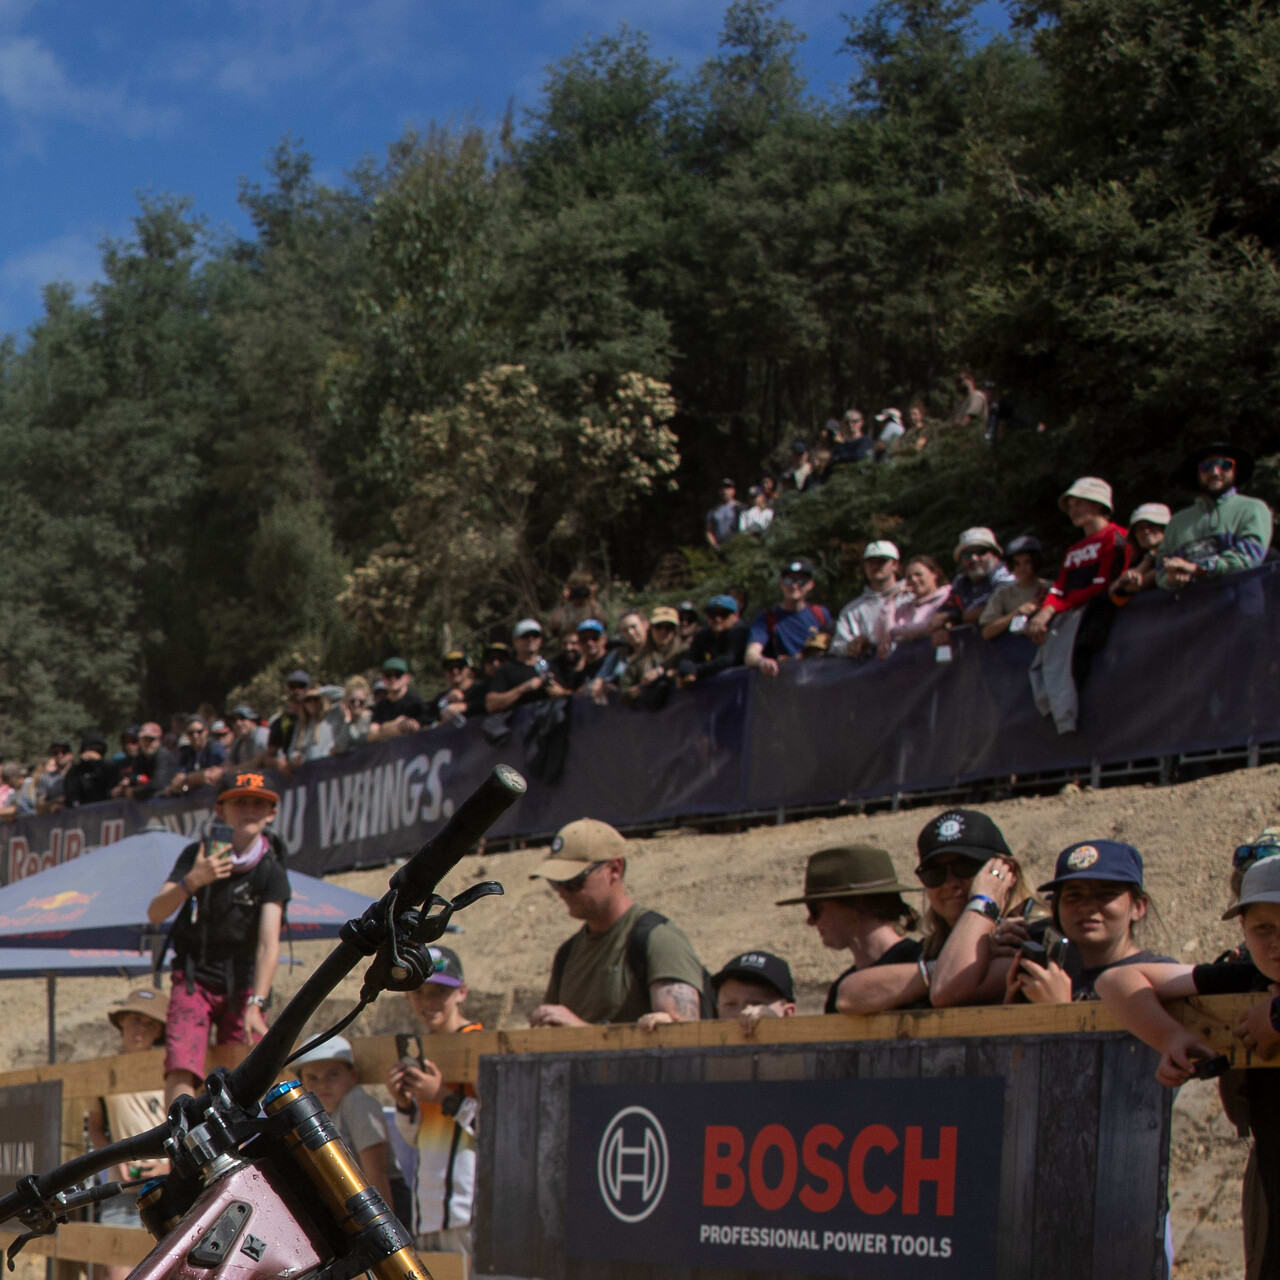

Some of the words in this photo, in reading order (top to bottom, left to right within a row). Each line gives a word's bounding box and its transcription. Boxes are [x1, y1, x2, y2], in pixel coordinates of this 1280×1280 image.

[65, 820, 124, 861] Bll
[701, 1122, 959, 1218] BOSCH
[699, 1224, 820, 1250] PROFESSIONAL
[823, 1231, 888, 1254] POWER
[890, 1234, 952, 1258] TOOLS
